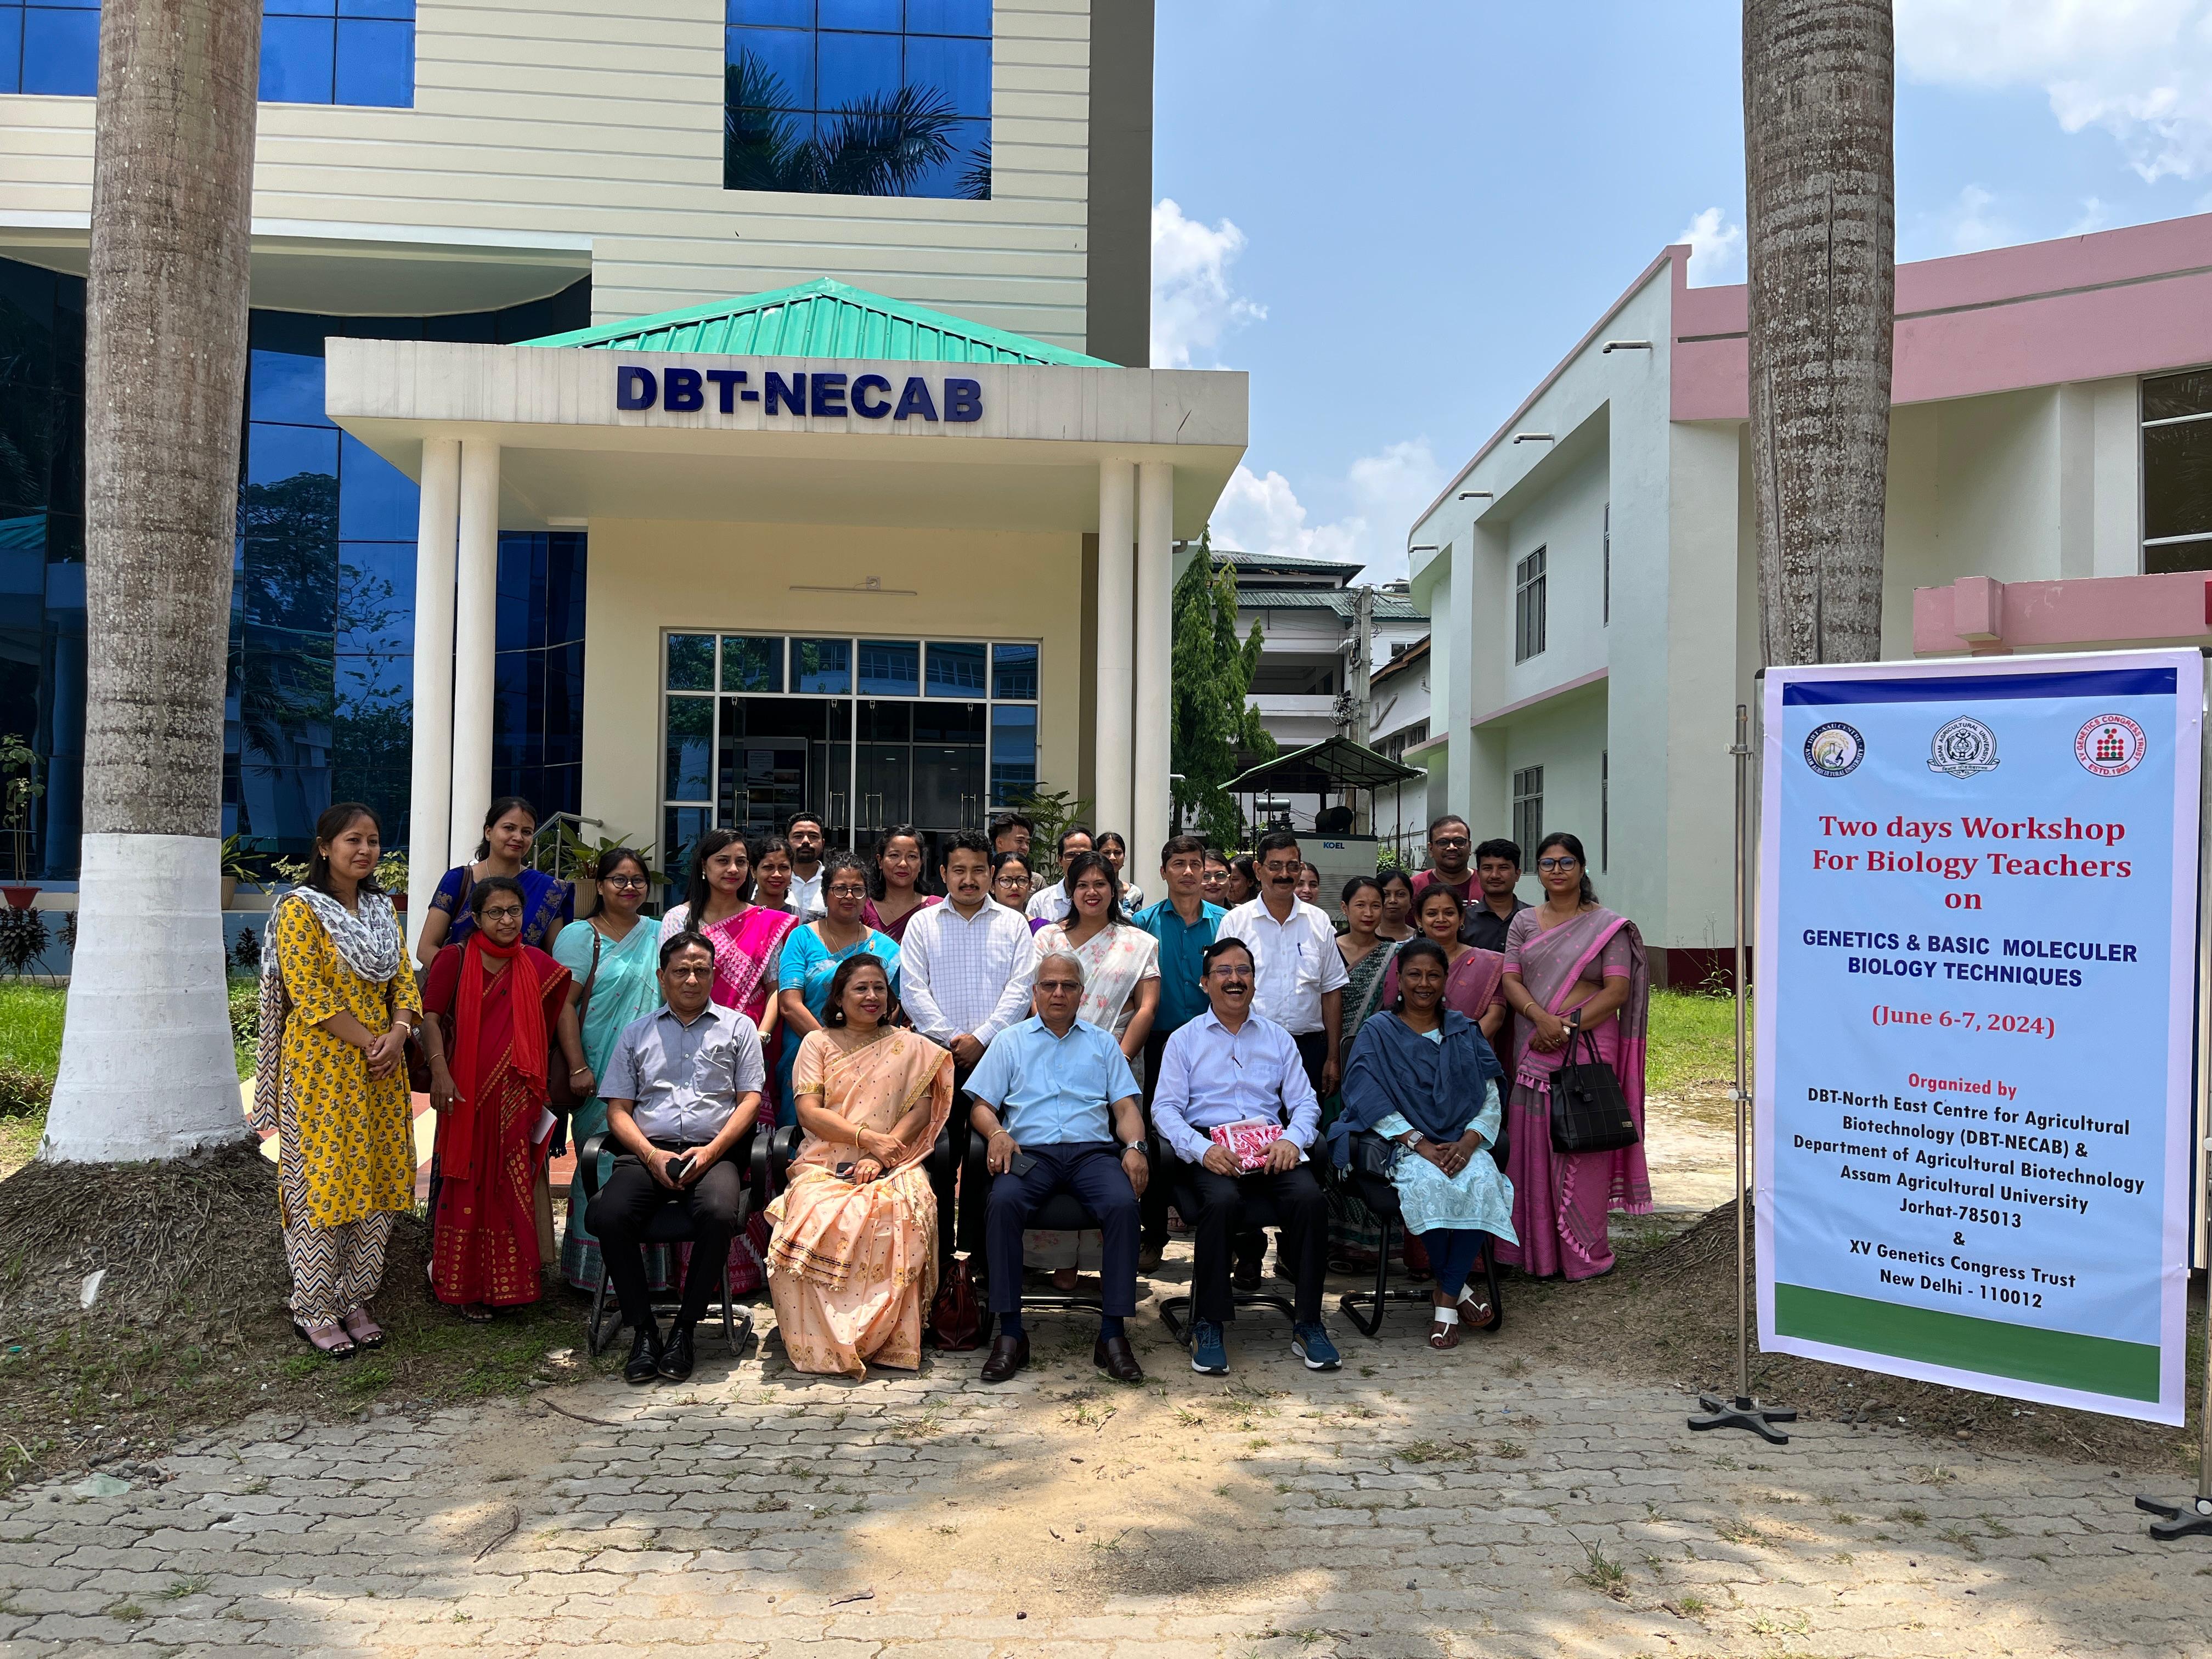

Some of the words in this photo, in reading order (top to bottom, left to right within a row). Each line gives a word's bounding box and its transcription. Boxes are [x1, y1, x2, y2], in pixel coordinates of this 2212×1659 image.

[617, 366, 983, 422] DBT-NECAB
[1939, 723, 1978, 743] AGRICULTURAL
[2077, 719, 2100, 750] GENETICS
[2102, 716, 2141, 737] CONGRESS
[1937, 745, 1948, 763] ASSAM
[1979, 730, 1989, 763] UNIVERSITY
[2078, 753, 2087, 761] XV
[2134, 737, 2144, 761] TRUST
[1819, 816, 1877, 837] Two
[1887, 816, 1952, 843] days
[1960, 817, 2125, 847] Workshop
[1813, 849, 1859, 871] For
[1866, 851, 1979, 880] Biology
[1987, 853, 2131, 878] Teachers
[1945, 893, 1982, 910] on
[1803, 929, 1899, 950] GENETICS
[1906, 934, 1921, 951] &
[1928, 935, 1990, 955] BASIC
[2003, 939, 2137, 962] MOLECULER
[1848, 957, 1938, 978] BIOLOGY
[1943, 962, 2082, 987] TECHNIQUES
[1872, 1005, 1932, 1026] (June
[1939, 1011, 1980, 1032] 6-7,
[1988, 1014, 2055, 1040] 2024)
[1909, 1073, 1991, 1094] Organized
[1998, 1081, 2017, 1101] by
[1808, 1087, 1888, 1109] DBT-North
[1894, 1096, 1928, 1114] East
[1933, 1101, 1988, 1120] Centre
[1994, 1107, 2019, 1124] for
[2024, 1110, 2129, 1135] Agricultural
[1843, 1115, 1955, 1146] Biotechnology
[1960, 1128, 2069, 1159] (DBT-NECAB)
[2075, 1142, 2088, 1158] &
[1794, 1135, 1887, 1159] Department
[1893, 1147, 1909, 1161] of
[1915, 1149, 2014, 1175] Agricultural
[2021, 1162, 2145, 1195] Biotechnology
[1840, 1165, 1891, 1184] Assam
[1897, 1172, 1994, 1199] Agricultural
[2001, 1186, 2089, 1215] University
[1899, 1198, 2021, 1228] Jorhat-785013
[1953, 1231, 1966, 1246] &
[1849, 1239, 1872, 1255] XV
[1877, 1244, 1945, 1267] Genetics
[1950, 1256, 2025, 1280] Congress
[2031, 1267, 2076, 1288] Trust
[1880, 1268, 1915, 1287] New
[1921, 1275, 1962, 1295] Delhi
[1980, 1284, 2042, 1308] 110012
